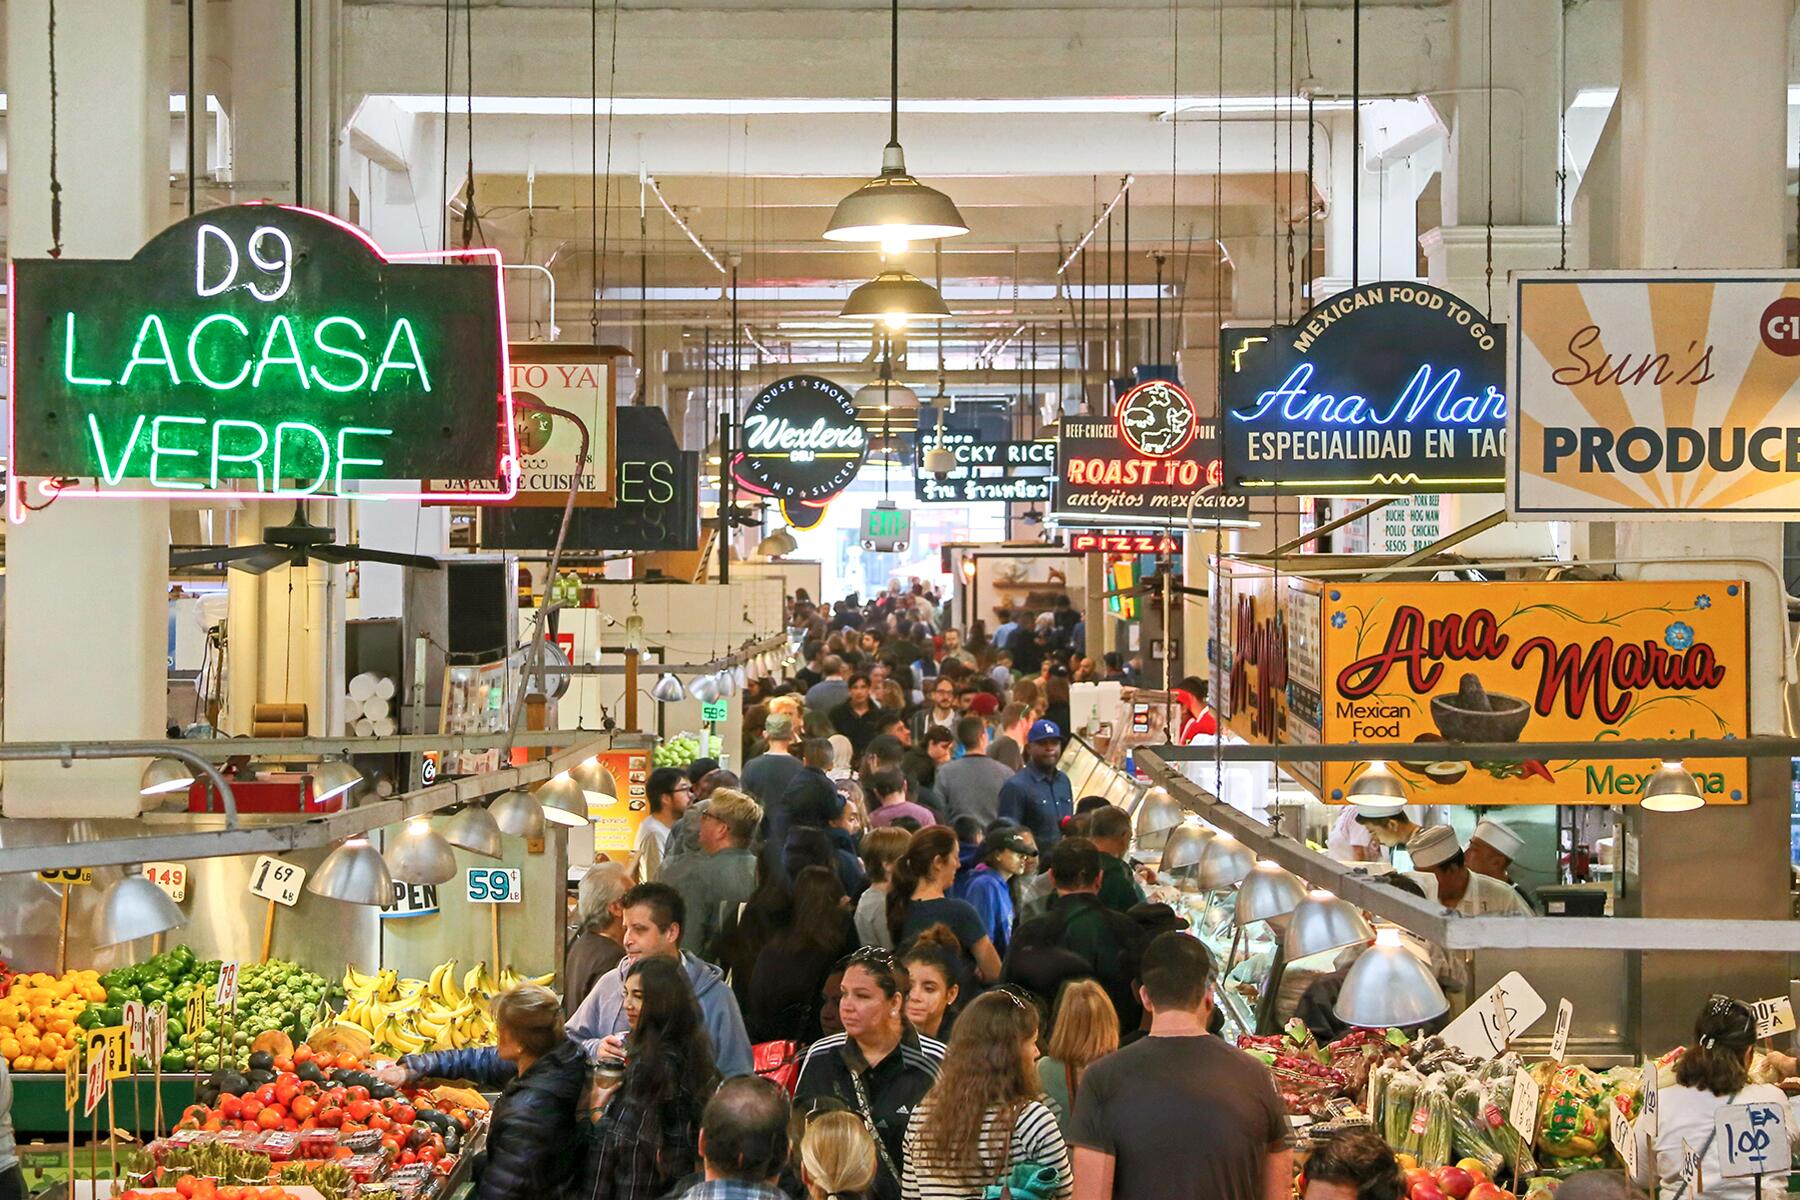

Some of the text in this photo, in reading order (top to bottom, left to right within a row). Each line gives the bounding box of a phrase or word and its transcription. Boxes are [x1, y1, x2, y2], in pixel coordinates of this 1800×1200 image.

[197, 223, 292, 302] D9
[1292, 287, 1495, 353] MEXICAN FOOD TO GO
[1551, 324, 1716, 387] Sun's
[556, 365, 599, 388] YA
[755, 380, 854, 415] HOUSE SMOKED
[1231, 362, 1367, 425] Ana
[88, 413, 393, 500] VERDE
[1008, 445, 1056, 462] RICE
[1247, 430, 1412, 461] ESPECIALIDAD
[1425, 429, 1455, 458] EN
[1543, 426, 1800, 474] PRODUCE
[445, 474, 527, 490] JAPANSE
[752, 461, 854, 496] HAND SLICED
[1067, 459, 1157, 485] ROAST
[1164, 459, 1199, 485] TO
[1067, 489, 1143, 513] antojitos
[1074, 536, 1177, 551] PIZZA
[1385, 525, 1439, 537] POLLO CHICKEN
[1385, 540, 1407, 552] SESOS
[1336, 604, 1510, 700] Ana
[1511, 635, 1726, 725] Maria
[1336, 702, 1411, 719] Mexican
[1352, 721, 1400, 738] Food
[1586, 765, 1726, 795] Mexna
[146, 867, 183, 885] 1.49
[282, 888, 295, 902] LB
[381, 882, 438, 912] PEN
[510, 892, 519, 900] LB
[1750, 1107, 1780, 1126] EA
